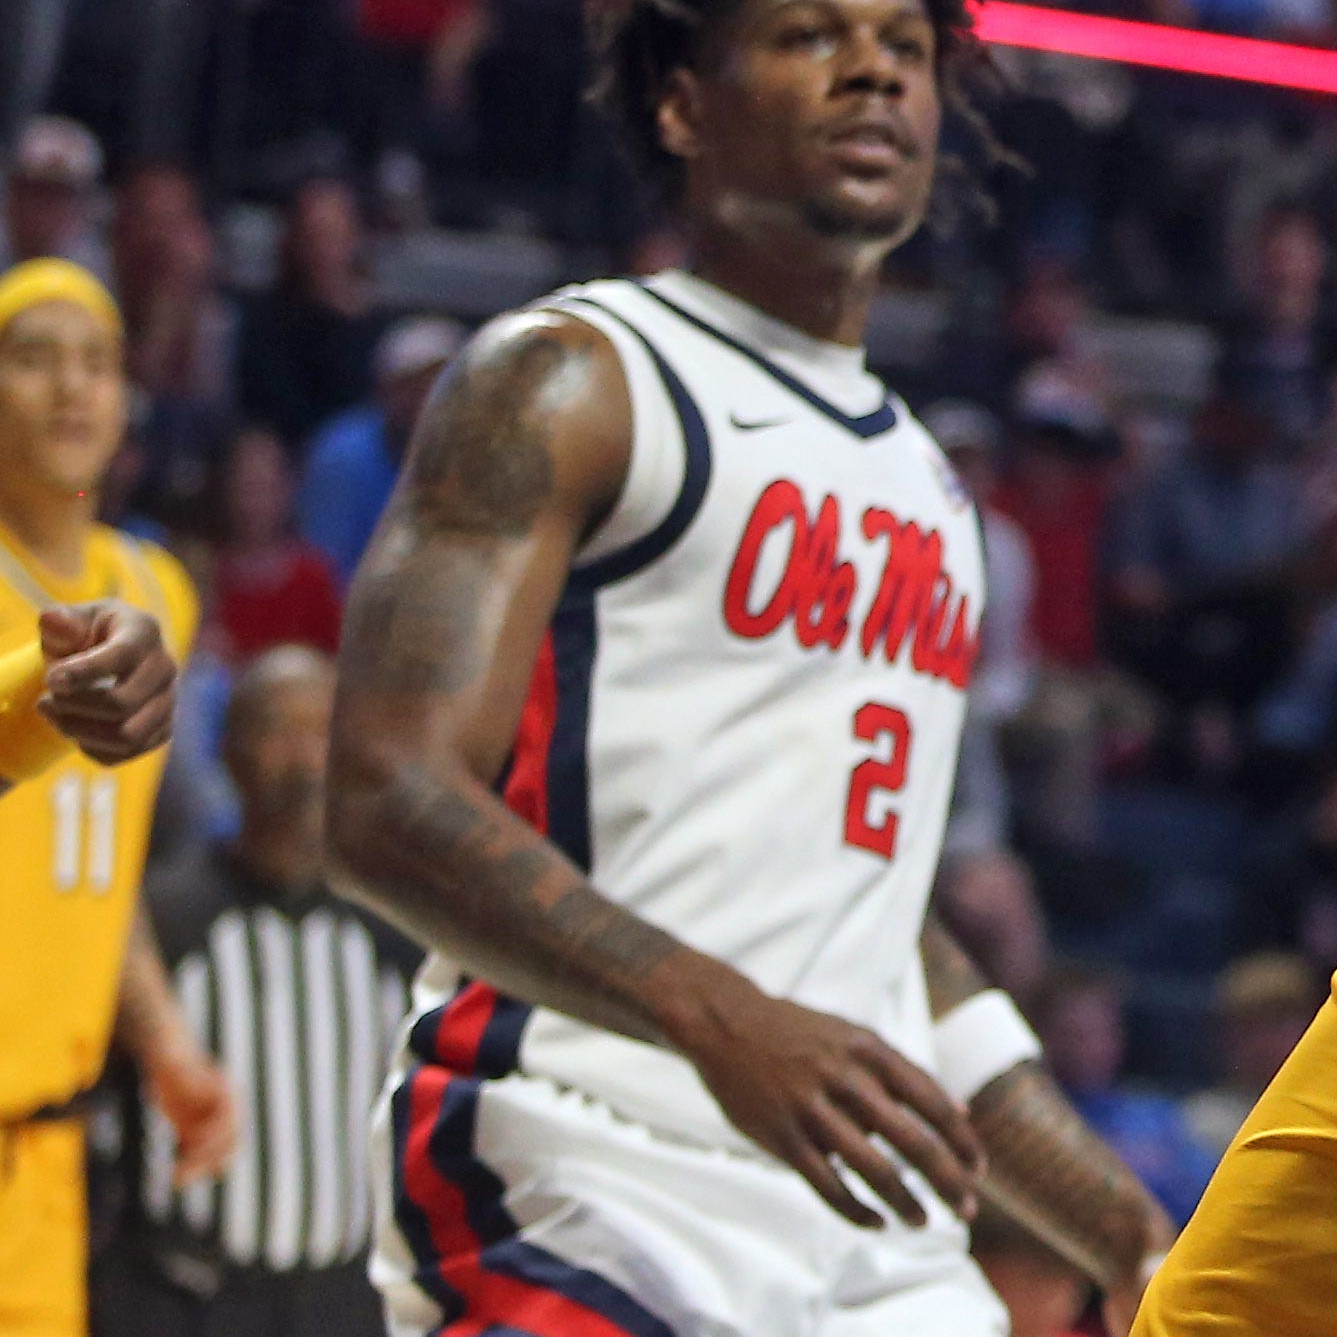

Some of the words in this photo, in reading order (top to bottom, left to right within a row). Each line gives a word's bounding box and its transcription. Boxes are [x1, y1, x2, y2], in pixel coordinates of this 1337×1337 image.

[722, 478, 857, 651] Ole
[51, 770, 118, 897] 11
[844, 701, 911, 861] 2
